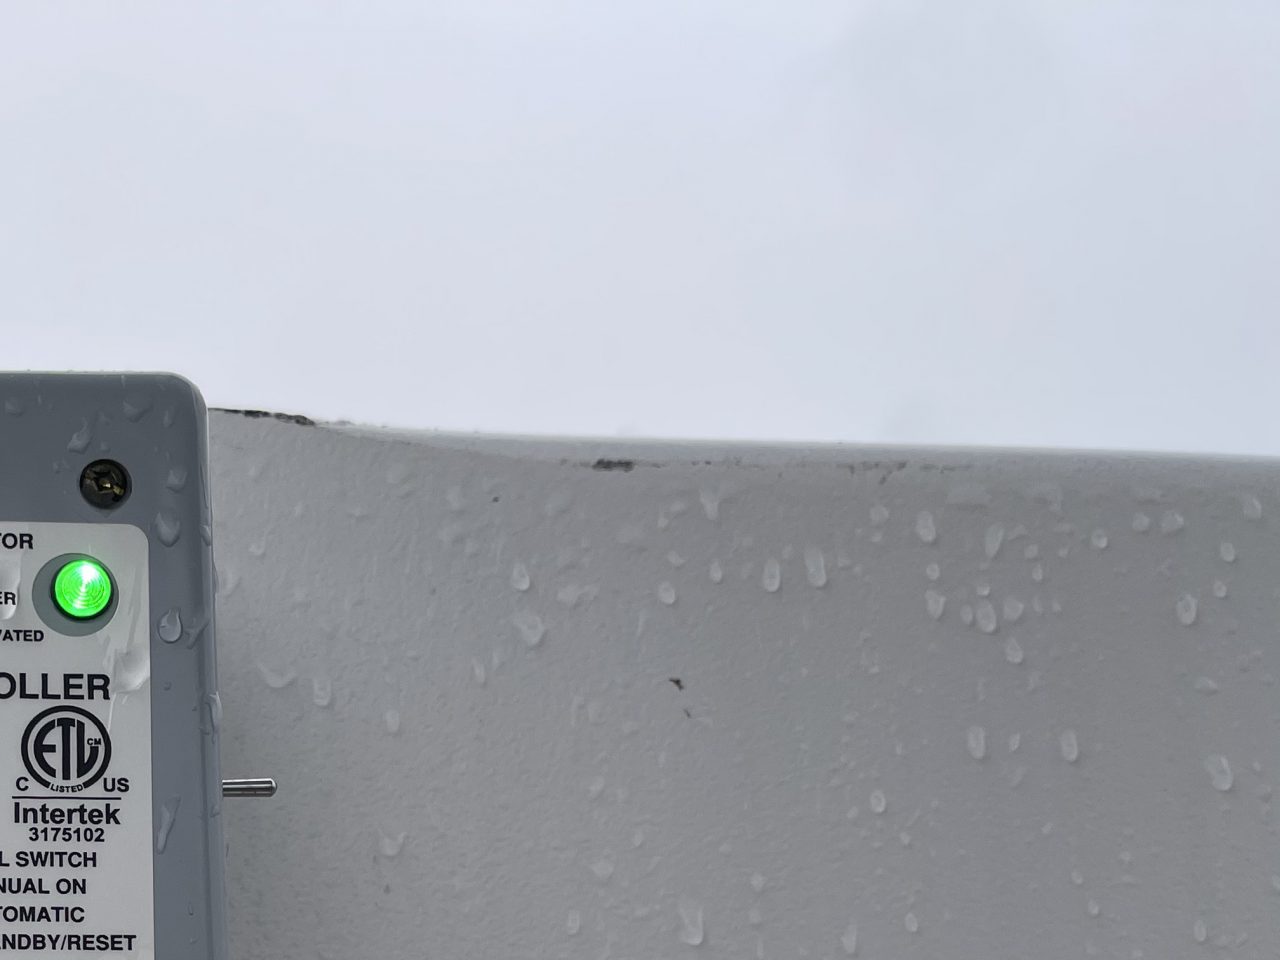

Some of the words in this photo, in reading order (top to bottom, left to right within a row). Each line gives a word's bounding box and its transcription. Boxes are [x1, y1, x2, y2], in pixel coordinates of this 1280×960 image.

[16, 777, 29, 791] C
[50, 783, 84, 793] LISTED
[104, 778, 129, 792] US
[15, 802, 120, 824] Intertek
[29, 827, 104, 842] 3175102
[16, 851, 96, 868] SWITCH
[56, 878, 86, 894] ON
